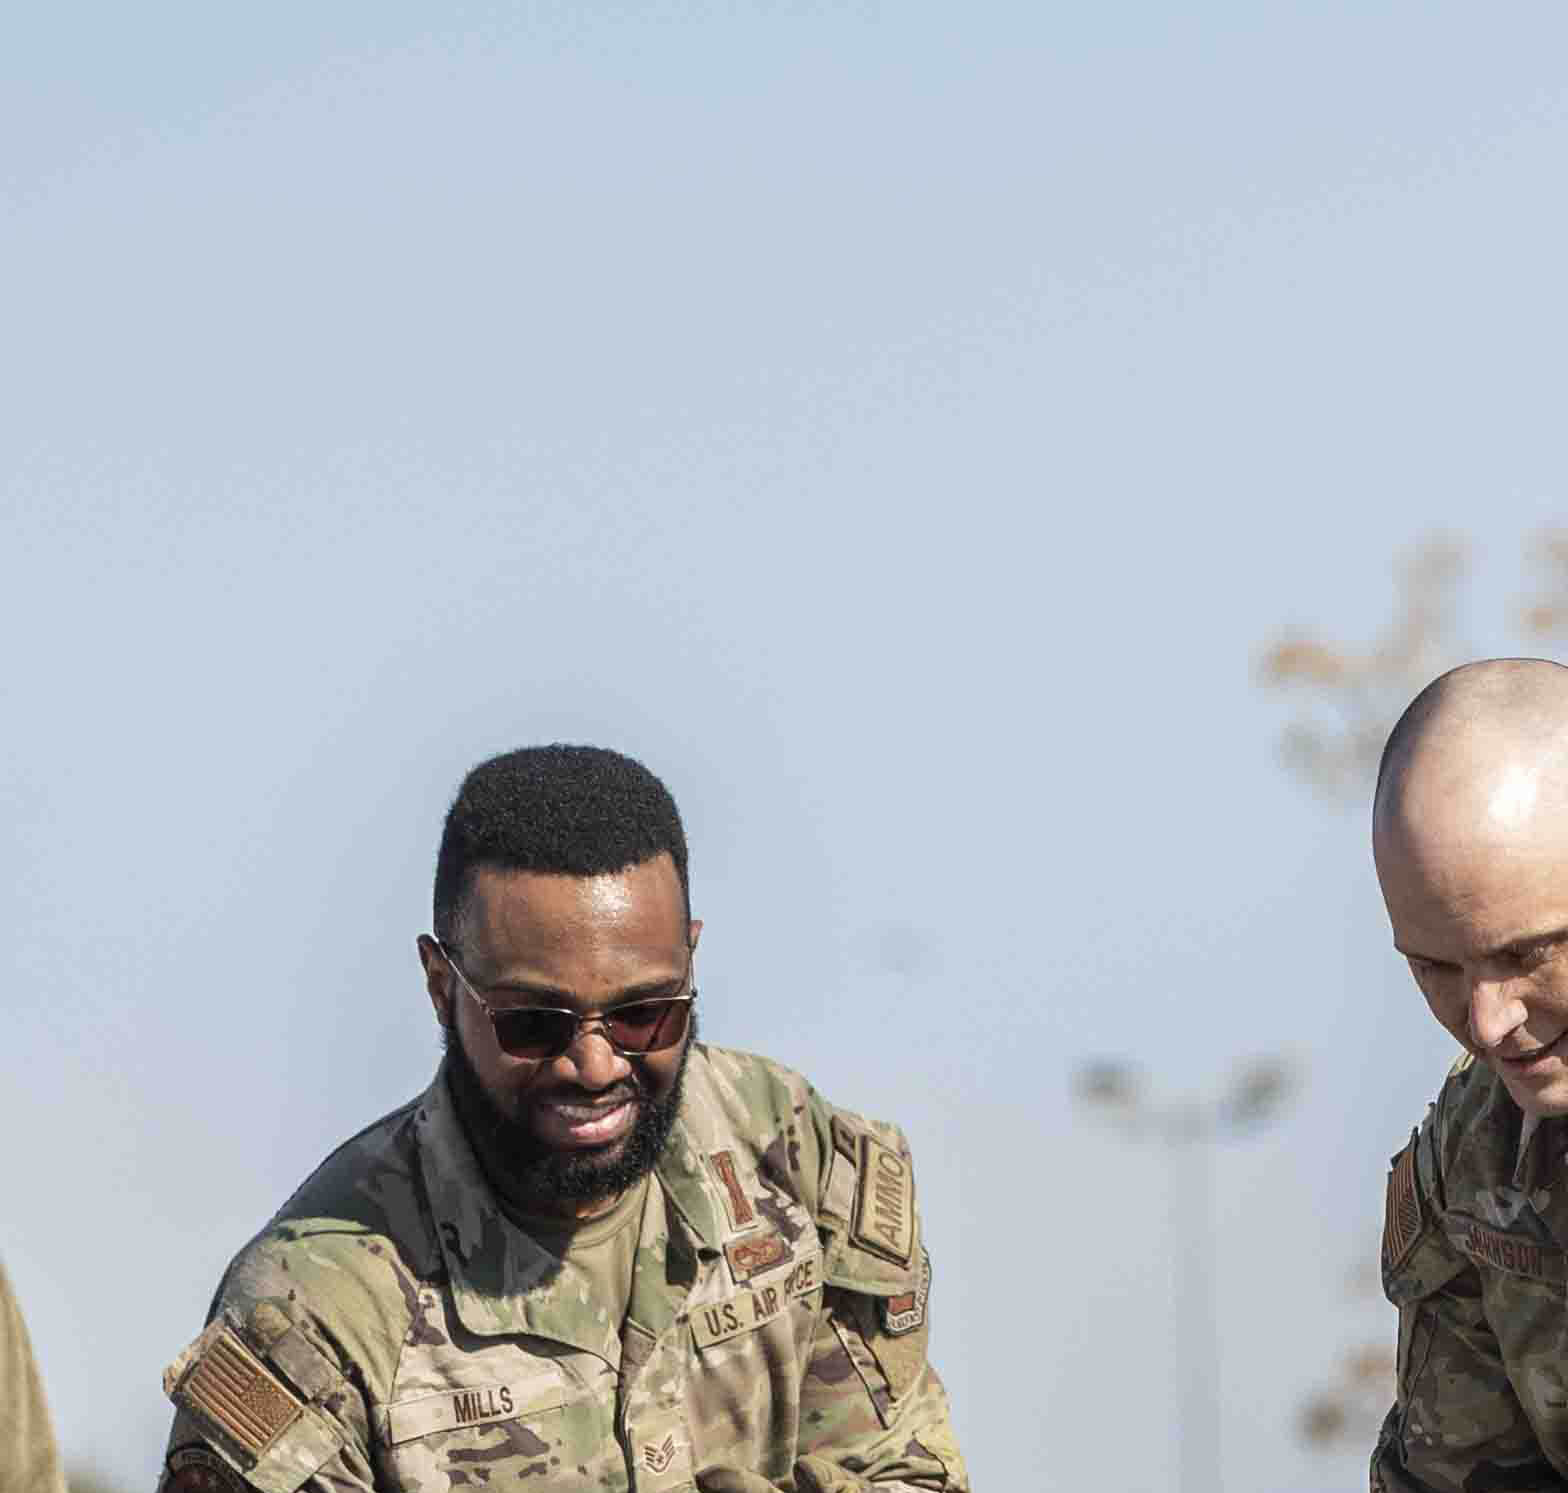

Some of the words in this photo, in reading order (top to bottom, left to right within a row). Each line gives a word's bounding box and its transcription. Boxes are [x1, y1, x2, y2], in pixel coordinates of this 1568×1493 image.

[872, 1150, 904, 1250] AMMO
[1463, 1228, 1543, 1276] JOHNSON
[704, 1303, 745, 1337] U.S.
[752, 1287, 780, 1321] AIR
[452, 1384, 515, 1426] MILLS
